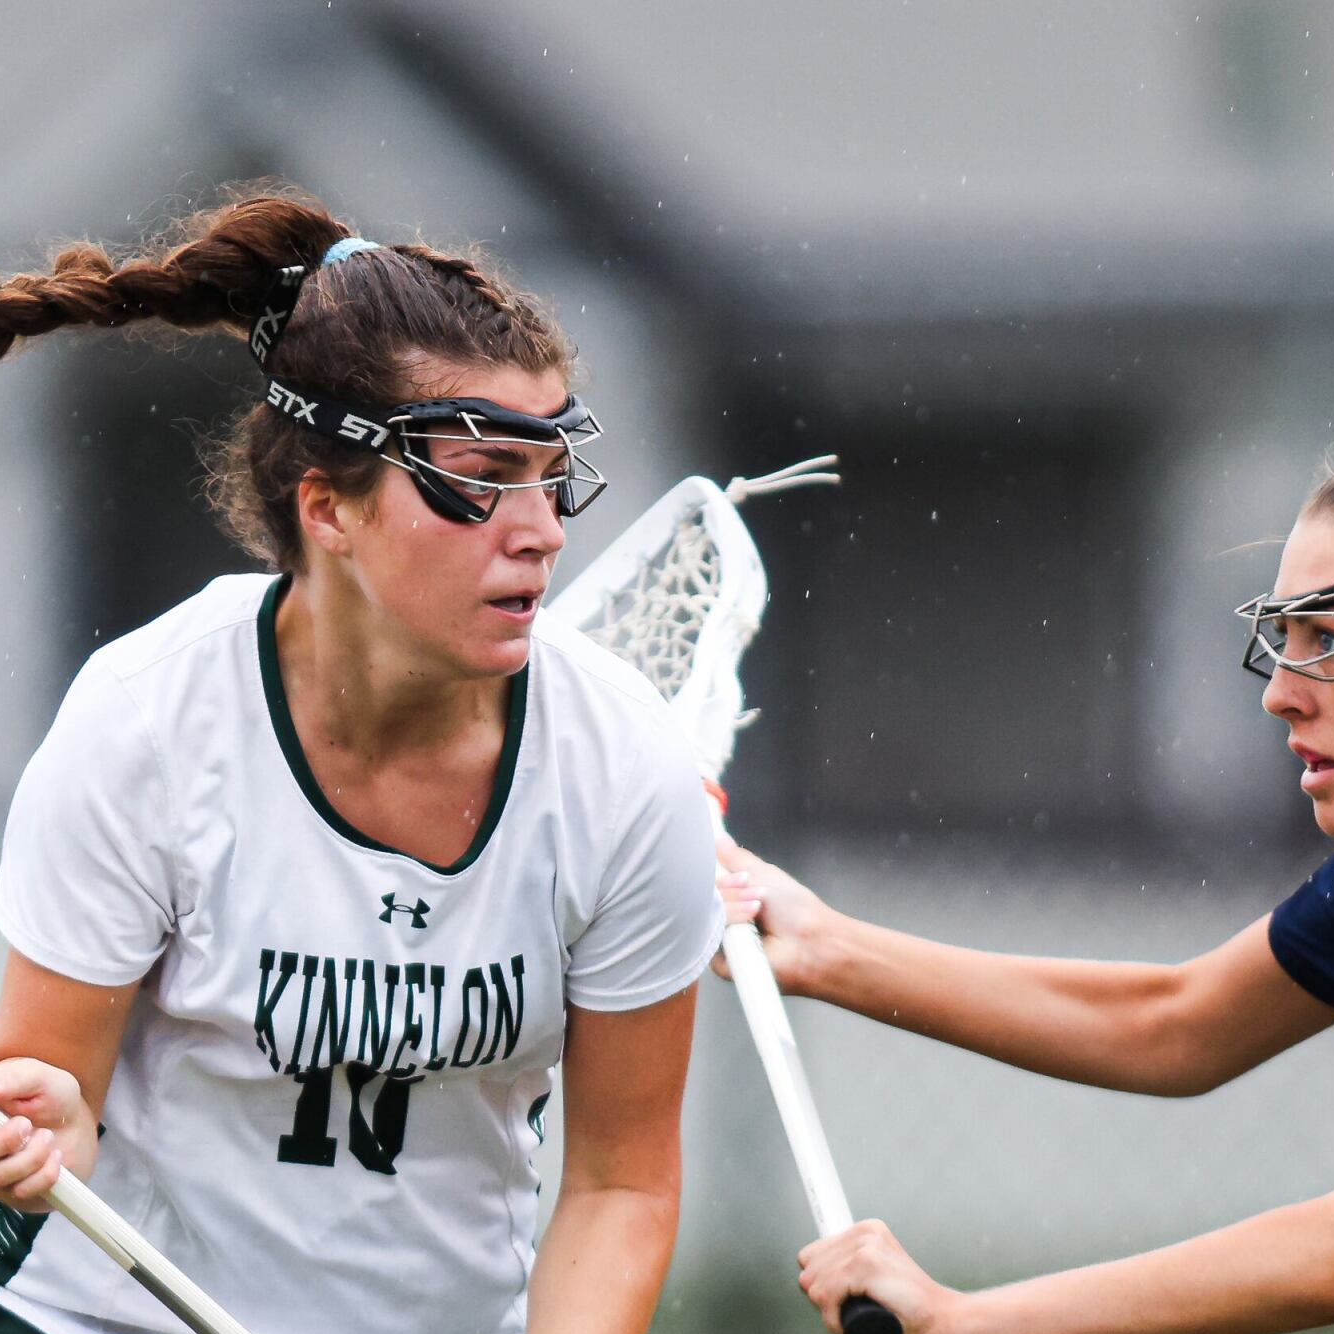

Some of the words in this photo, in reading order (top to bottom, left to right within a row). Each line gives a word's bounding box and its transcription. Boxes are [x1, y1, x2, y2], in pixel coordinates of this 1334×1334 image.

[251, 305, 288, 364] STX
[267, 380, 319, 425] STX
[254, 948, 525, 1077] KINNELON
[277, 1060, 425, 1175] 10
